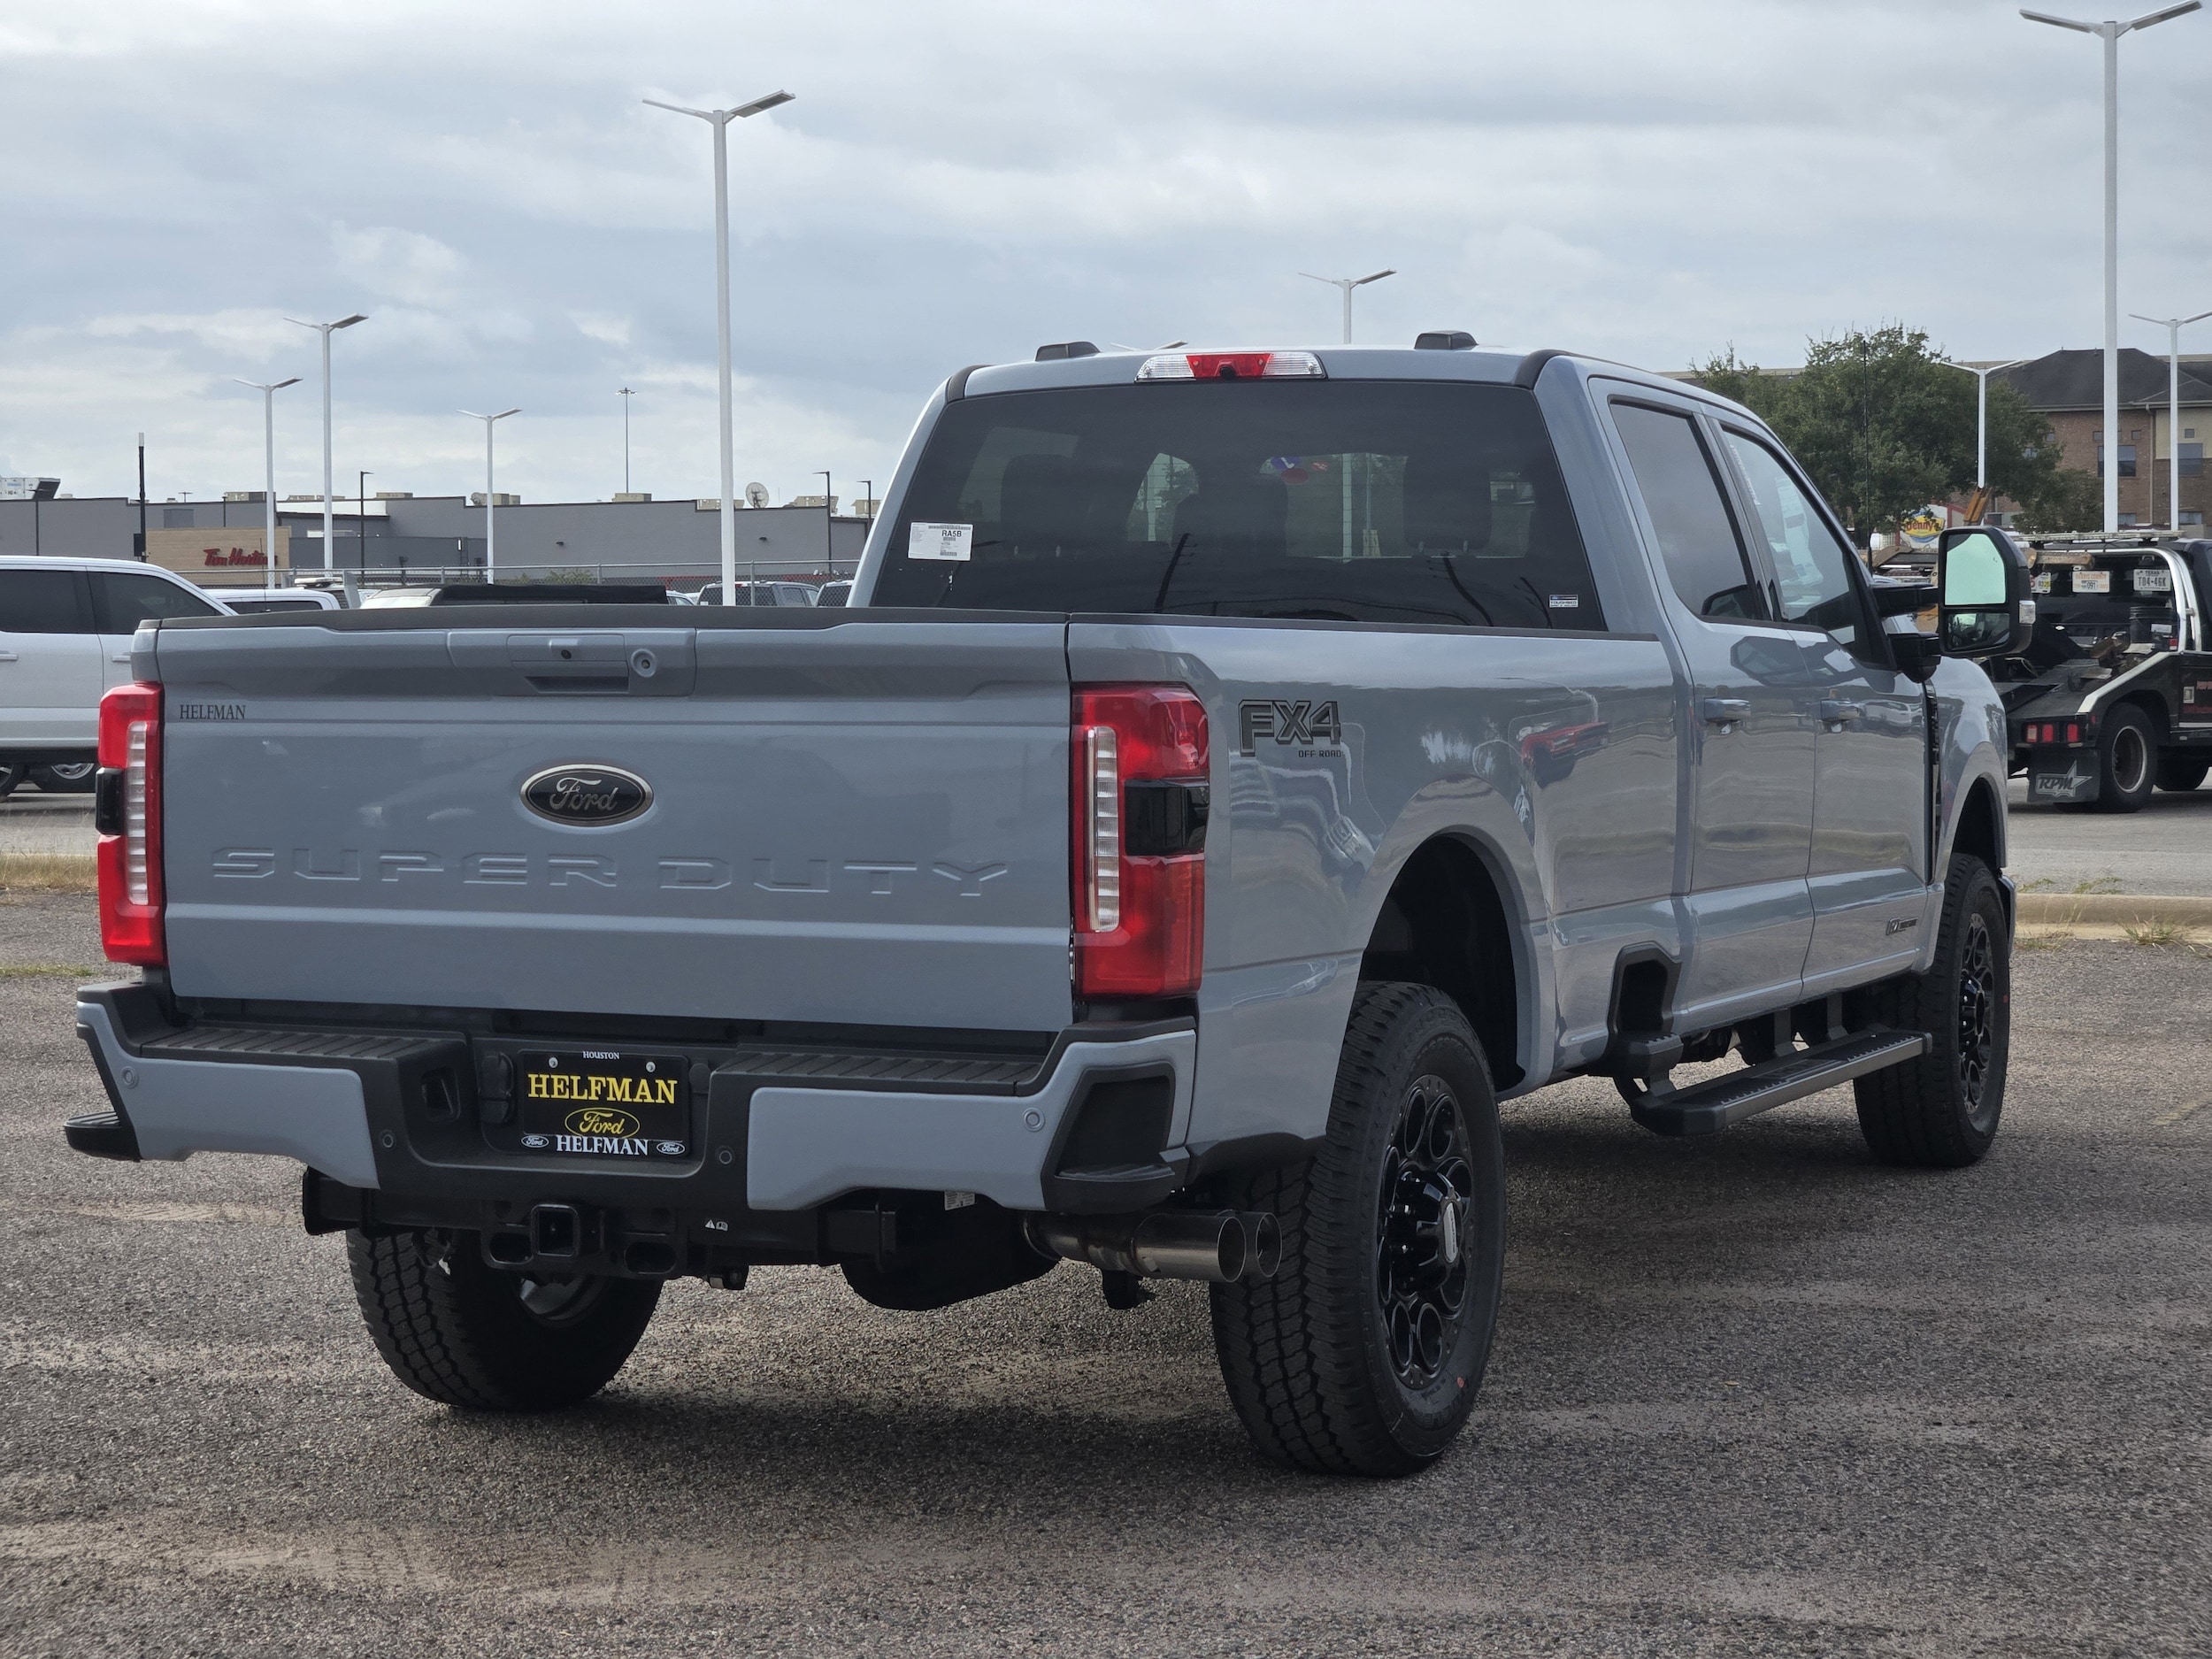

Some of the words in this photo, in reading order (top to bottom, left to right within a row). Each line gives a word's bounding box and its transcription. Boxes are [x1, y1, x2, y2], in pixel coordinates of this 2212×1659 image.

[203, 549, 227, 566] Tim
[180, 704, 246, 719] HELFMAN
[1238, 699, 1341, 757] FX4
[549, 777, 618, 810] Ford
[2038, 777, 2074, 790] RPM
[212, 847, 617, 888] SUPER
[658, 856, 1008, 897] DUTY
[582, 1050, 619, 1060] HOUSTON
[527, 1073, 678, 1104] HELFMAN
[579, 1110, 625, 1134] Ford
[557, 1134, 649, 1156] HELFMAN
